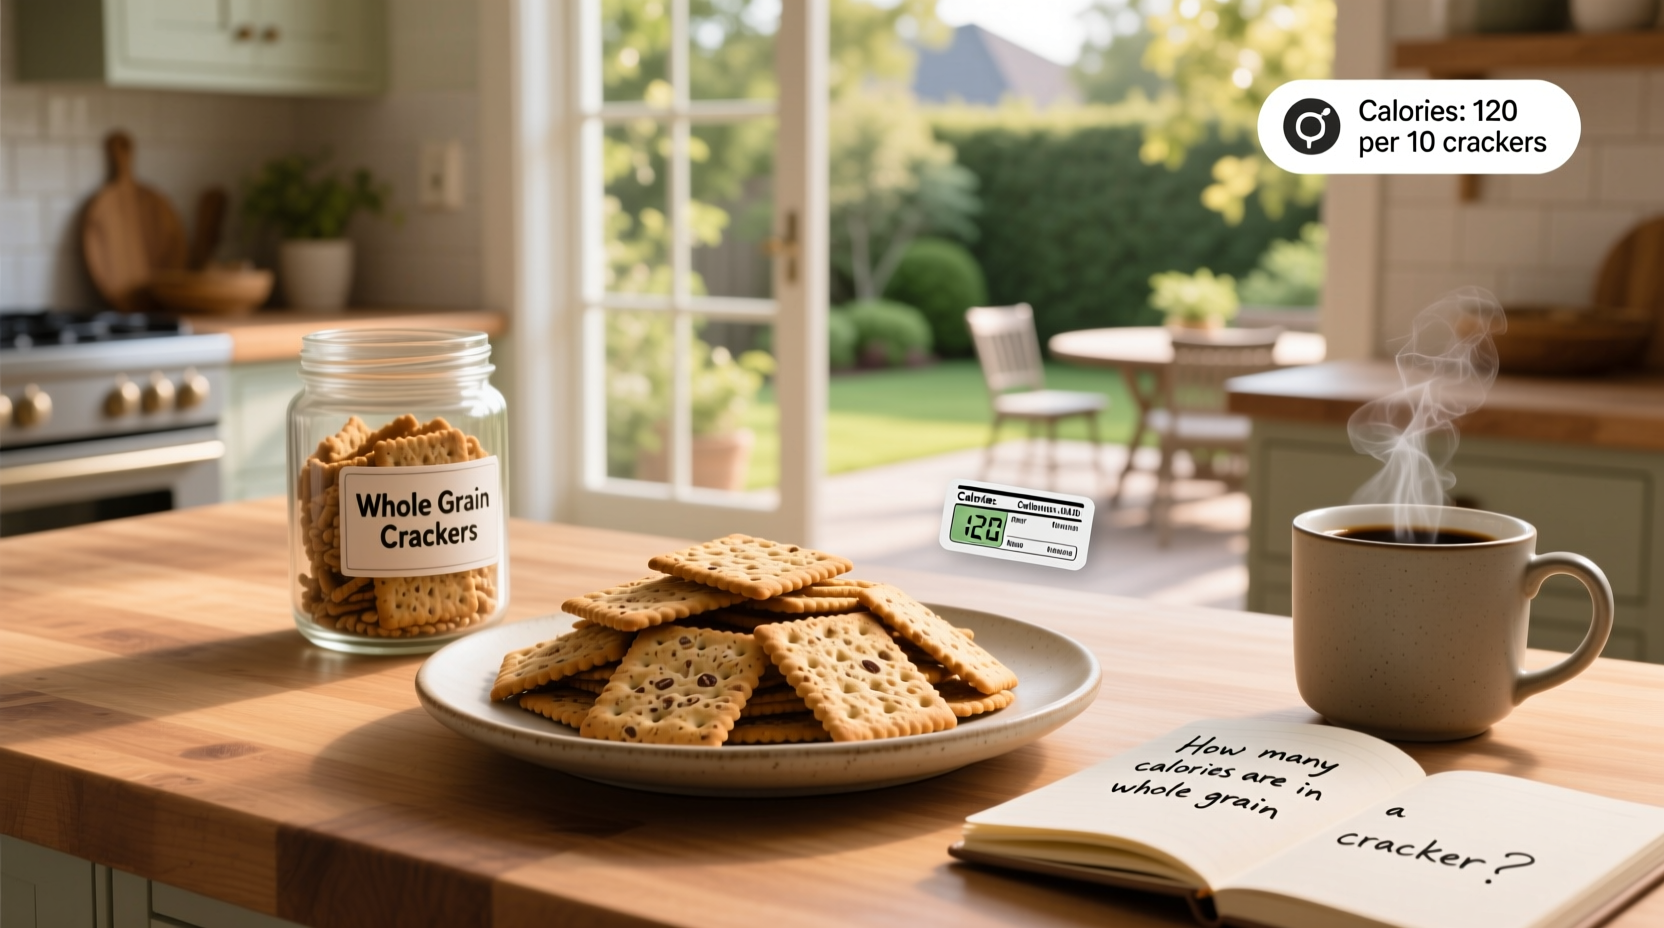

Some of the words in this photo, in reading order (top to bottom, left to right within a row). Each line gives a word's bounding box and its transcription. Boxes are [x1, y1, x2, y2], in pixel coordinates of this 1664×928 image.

[356, 491, 432, 518] Whole
[437, 486, 490, 515] Grain
[380, 521, 478, 549] Crackers
[964, 514, 1003, 542] 120
[1176, 735, 1247, 757] How
[1258, 747, 1340, 778] many
[1134, 759, 1236, 779] calories
[1242, 769, 1287, 788] are
[1296, 782, 1322, 802] in
[1111, 780, 1192, 799] whole
[1194, 790, 1279, 820] grain
[1386, 805, 1406, 819] a
[1336, 832, 1536, 885] cracker?
